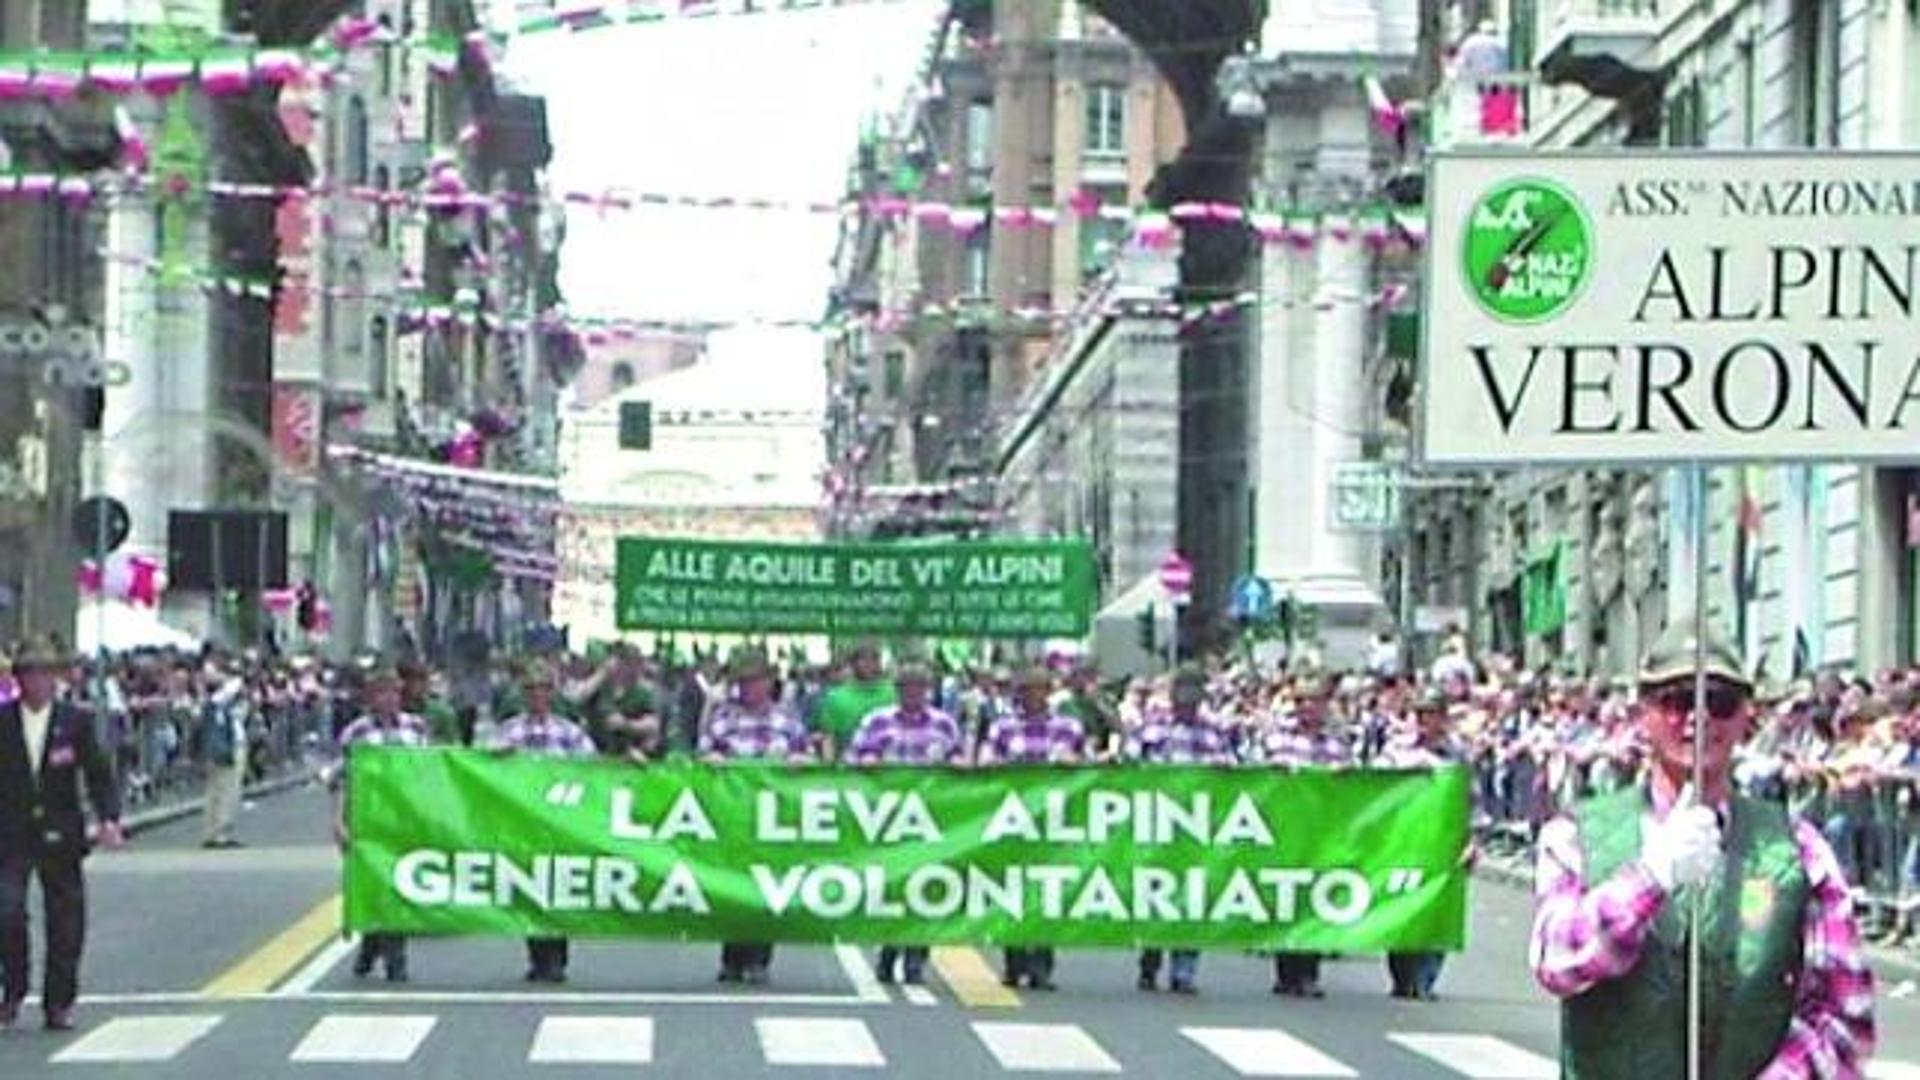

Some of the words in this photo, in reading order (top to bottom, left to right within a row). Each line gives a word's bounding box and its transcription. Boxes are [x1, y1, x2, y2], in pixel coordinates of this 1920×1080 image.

[647, 549, 716, 581] ALLE
[724, 554, 836, 586] AQUILE
[851, 557, 902, 587] DEL
[963, 554, 1064, 584] ALPINI
[610, 787, 717, 841] LA
[755, 790, 943, 843] LEVA
[981, 791, 1275, 846] ALPINA
[393, 849, 711, 914] GENERA
